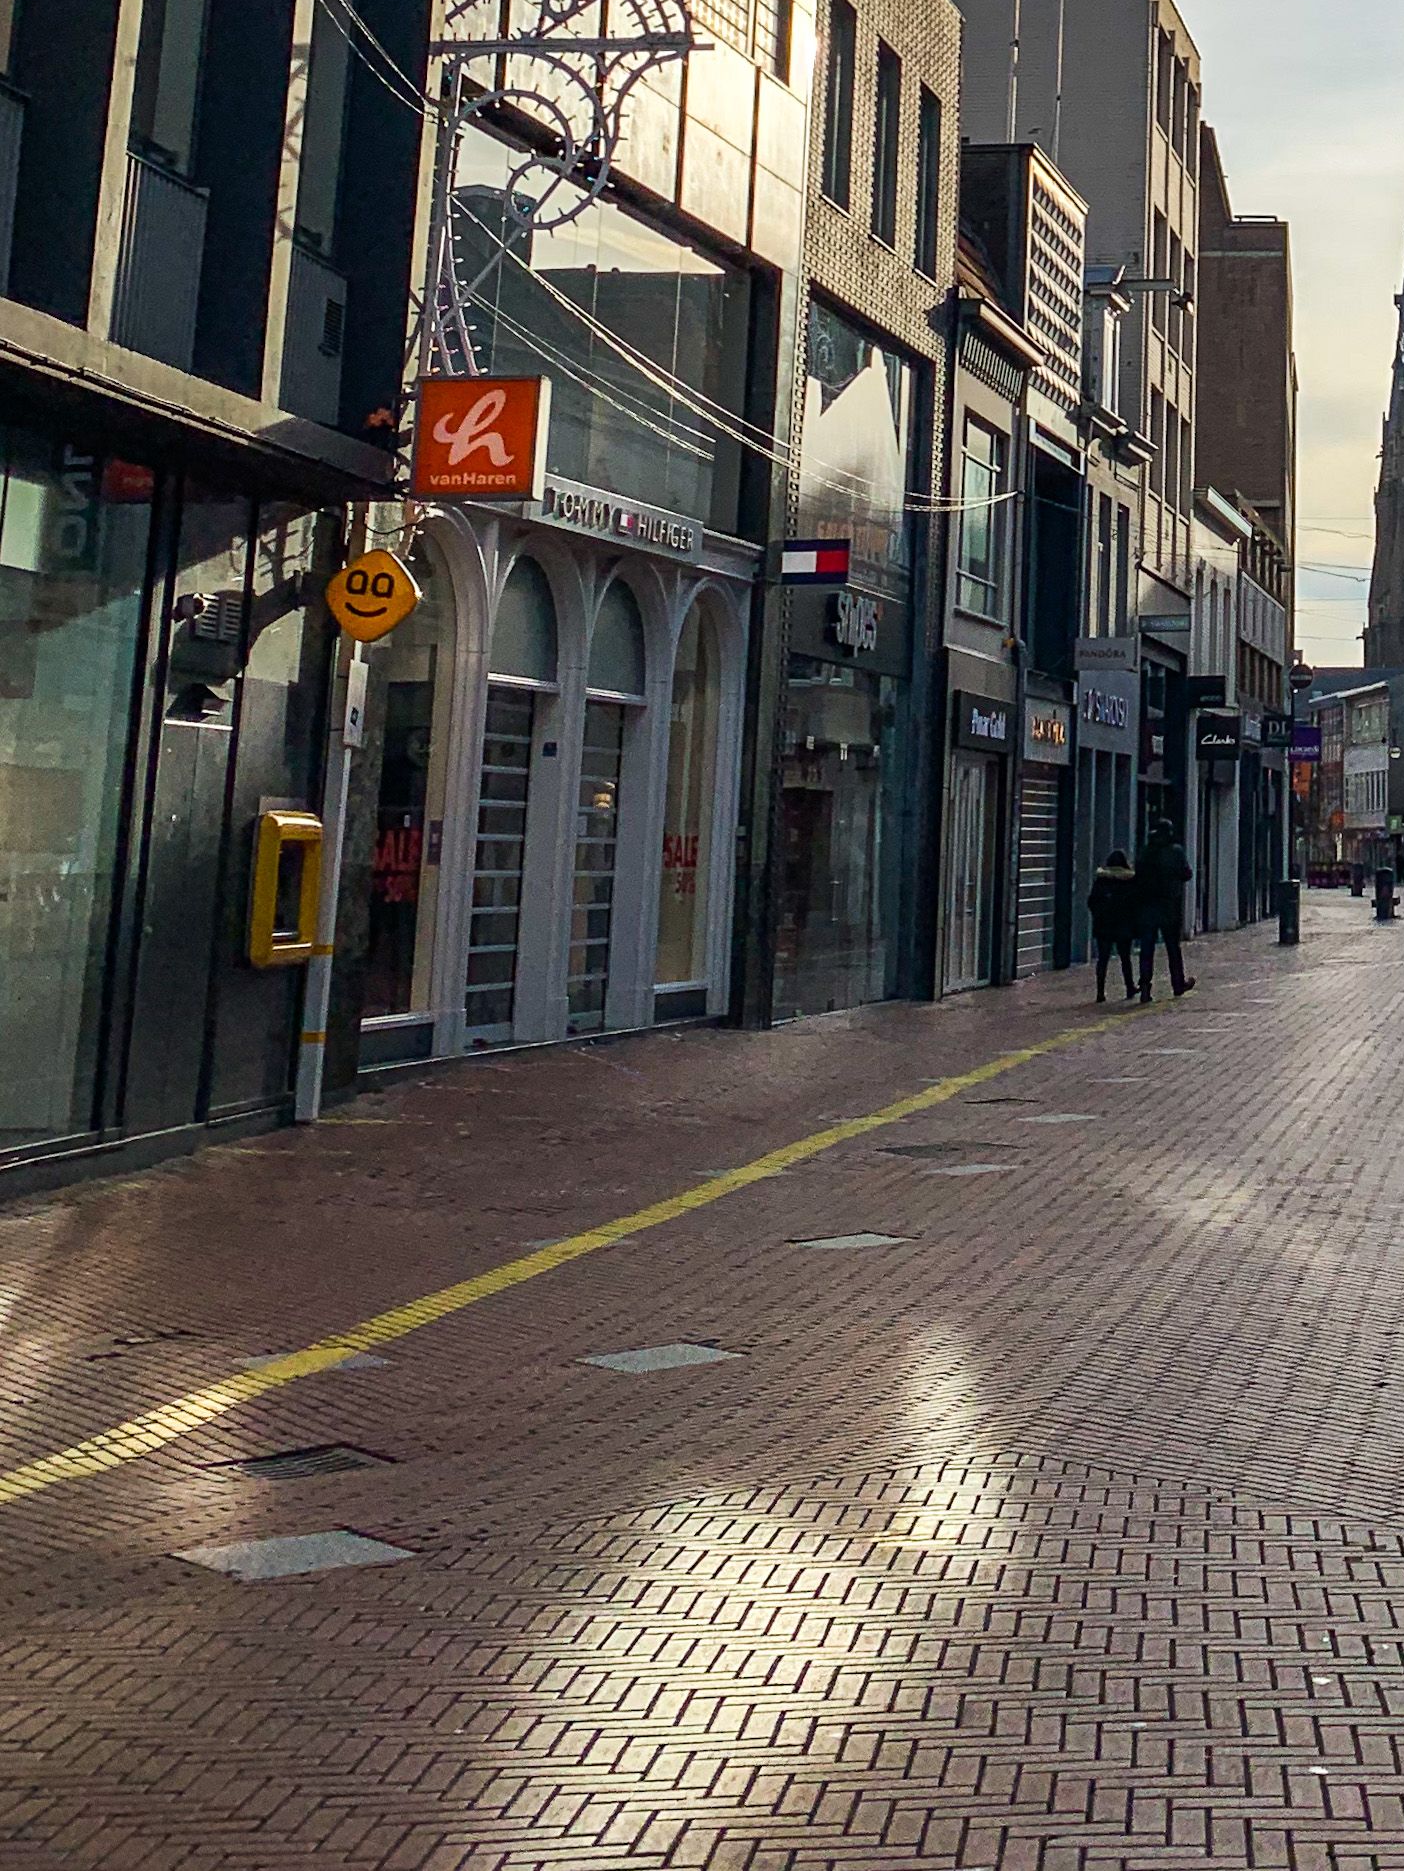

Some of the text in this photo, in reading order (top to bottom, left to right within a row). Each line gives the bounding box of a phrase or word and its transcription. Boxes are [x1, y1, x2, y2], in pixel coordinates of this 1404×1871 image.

[430, 473, 516, 485] vanHaren
[551, 487, 694, 549] TOMMY HILFIGER
[1201, 734, 1236, 745] Clarks
[663, 834, 699, 869] SALE
